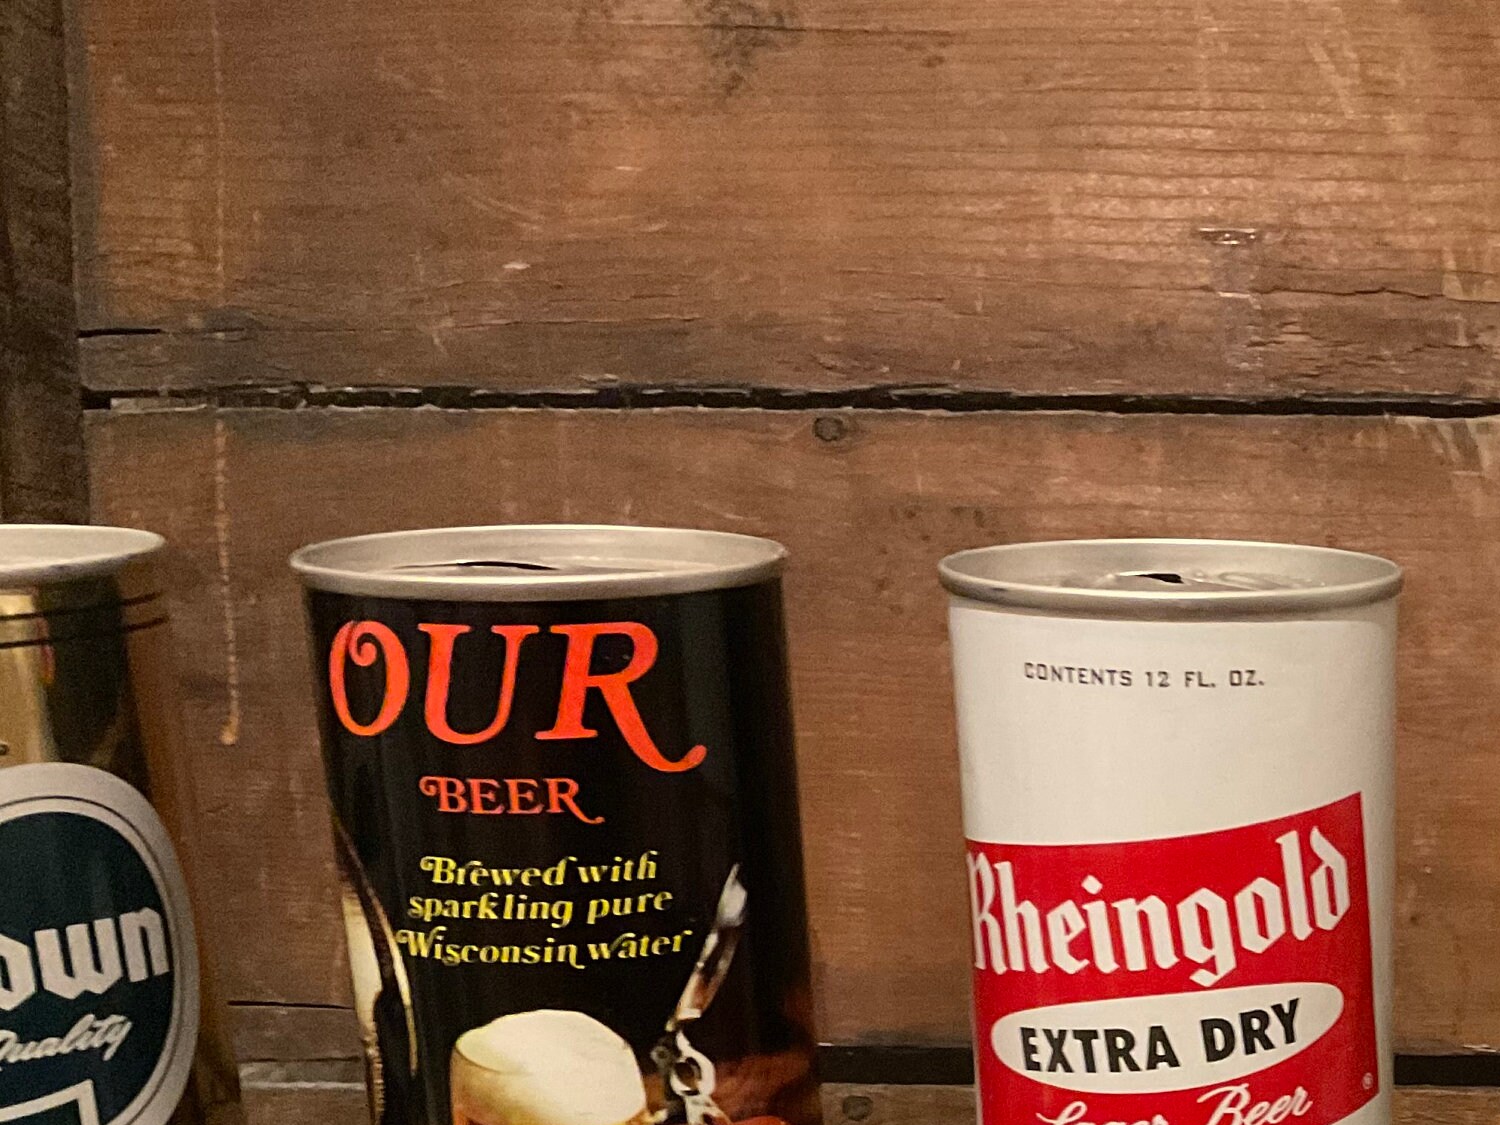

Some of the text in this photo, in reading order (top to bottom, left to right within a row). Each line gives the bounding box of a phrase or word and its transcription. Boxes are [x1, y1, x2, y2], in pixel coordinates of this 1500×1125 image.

[329, 619, 707, 773] OUR
[1024, 661, 1265, 688] CONTENTS 12 FL. OZ.
[419, 776, 605, 823] BEER
[420, 851, 657, 886] Brewed with
[407, 890, 673, 928] sparkling pure
[966, 825, 1351, 987] Rheingold
[396, 926, 692, 969] Wisconsin water
[1020, 997, 1300, 1074] EXTRA DRY
